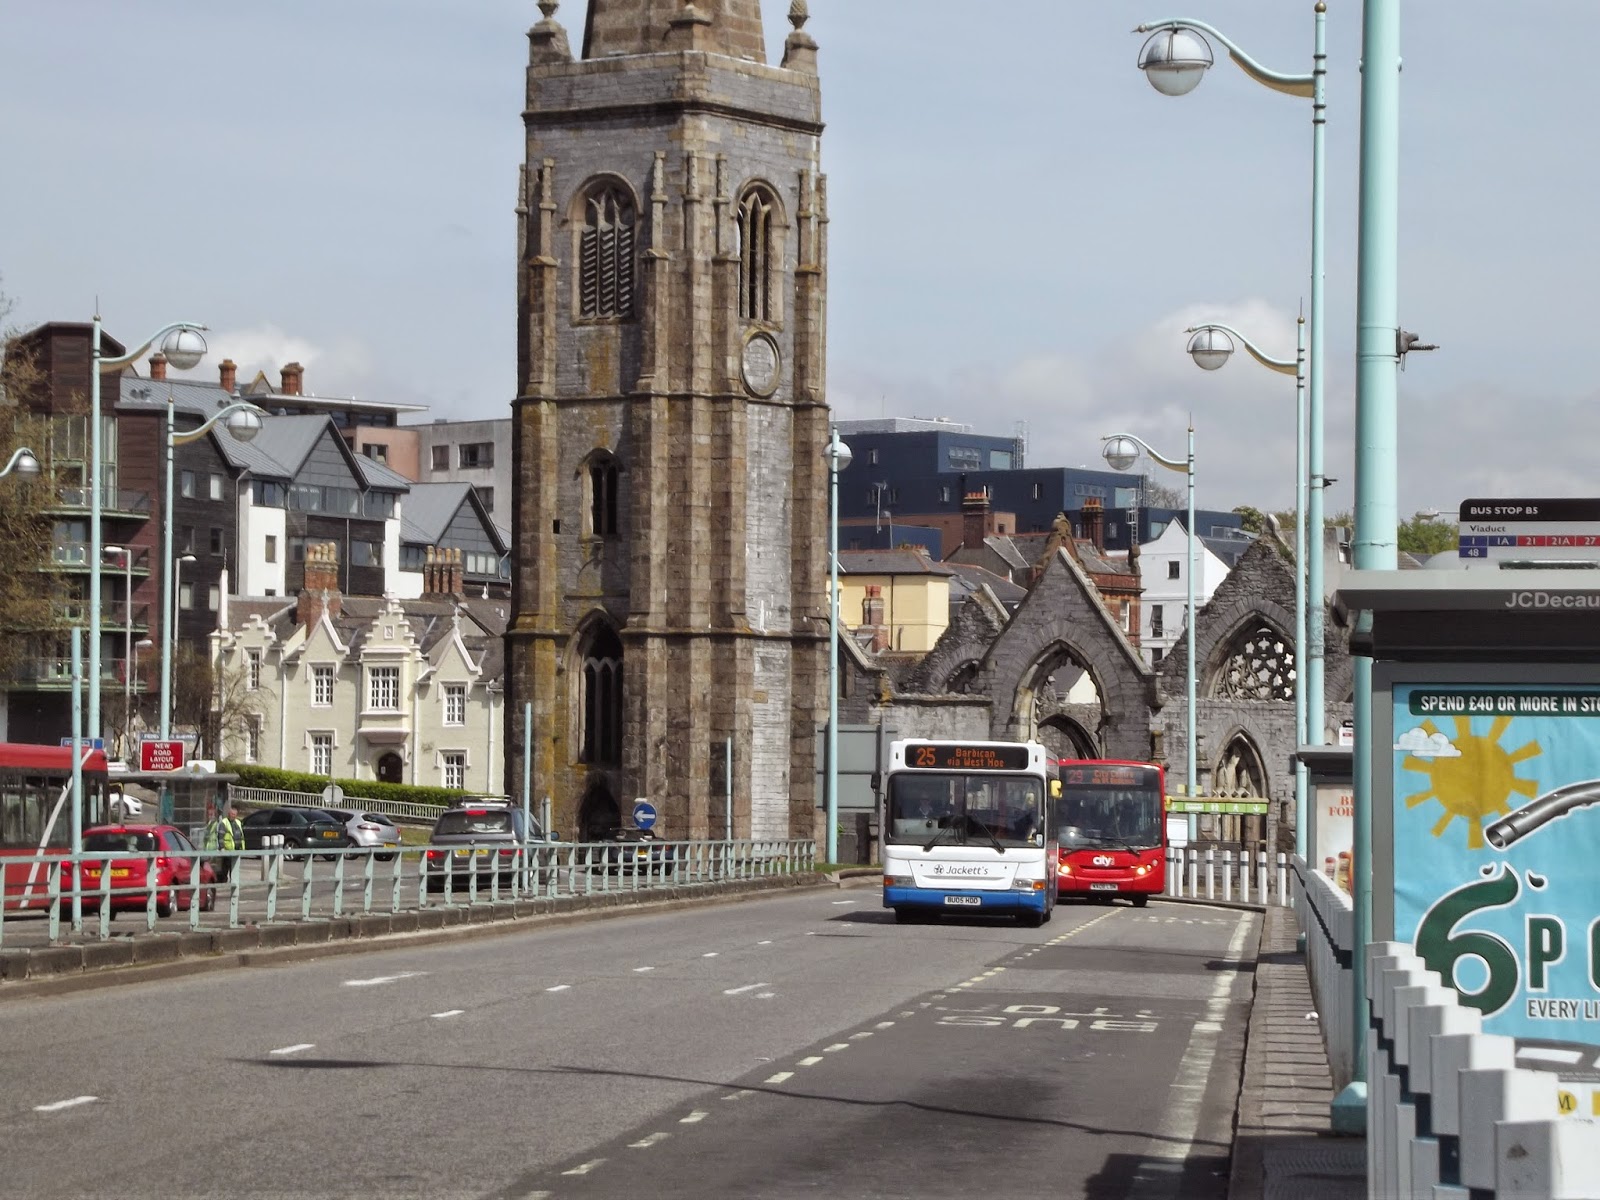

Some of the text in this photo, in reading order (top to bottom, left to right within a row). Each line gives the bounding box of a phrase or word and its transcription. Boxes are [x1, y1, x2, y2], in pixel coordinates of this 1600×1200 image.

[1470, 506, 1539, 515] BUS STOP B5
[1470, 525, 1506, 533] Viaduct
[1471, 537, 1596, 545] 1 1A 21 21A 27
[1468, 548, 1480, 557] 48
[1504, 591, 1600, 608] JCDecau
[1421, 695, 1465, 711] SPEND
[1468, 696, 1494, 711] £40
[1497, 696, 1517, 711] OR
[1520, 696, 1558, 712] MORE
[1562, 697, 1577, 712] IN
[916, 747, 996, 766] 25 Barbican
[964, 758, 985, 767] West
[987, 759, 1005, 768] Hoe
[1092, 854, 1111, 867] city
[945, 865, 989, 875] Jackett's
[1528, 1000, 1578, 1018] EVERY
